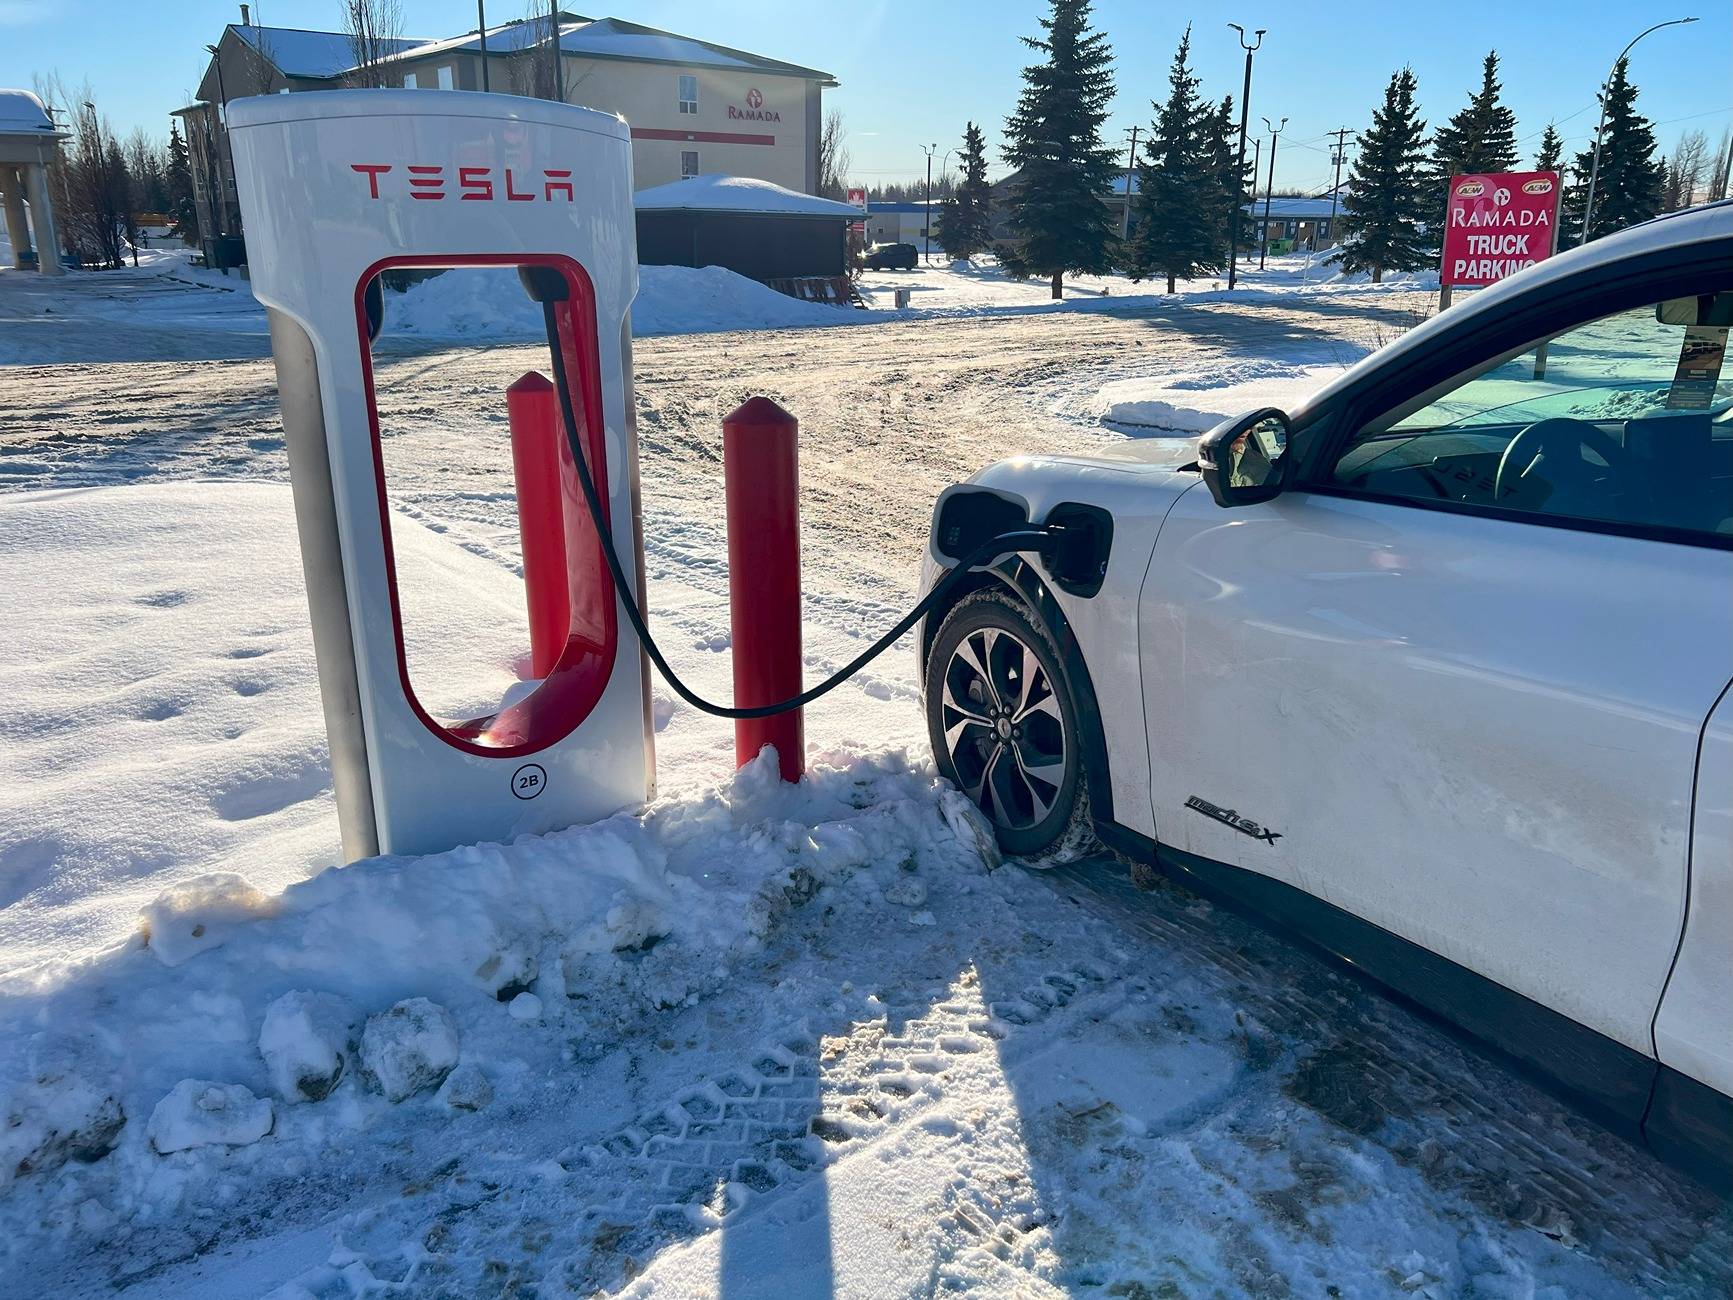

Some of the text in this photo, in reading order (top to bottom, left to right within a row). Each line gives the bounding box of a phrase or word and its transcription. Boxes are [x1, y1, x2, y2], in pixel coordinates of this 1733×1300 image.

[728, 105, 781, 123] RAMADA
[350, 164, 574, 202] TESLA
[1452, 208, 1549, 228] RAMADA
[1467, 234, 1530, 255] TRUCK
[519, 774, 539, 789] 2B
